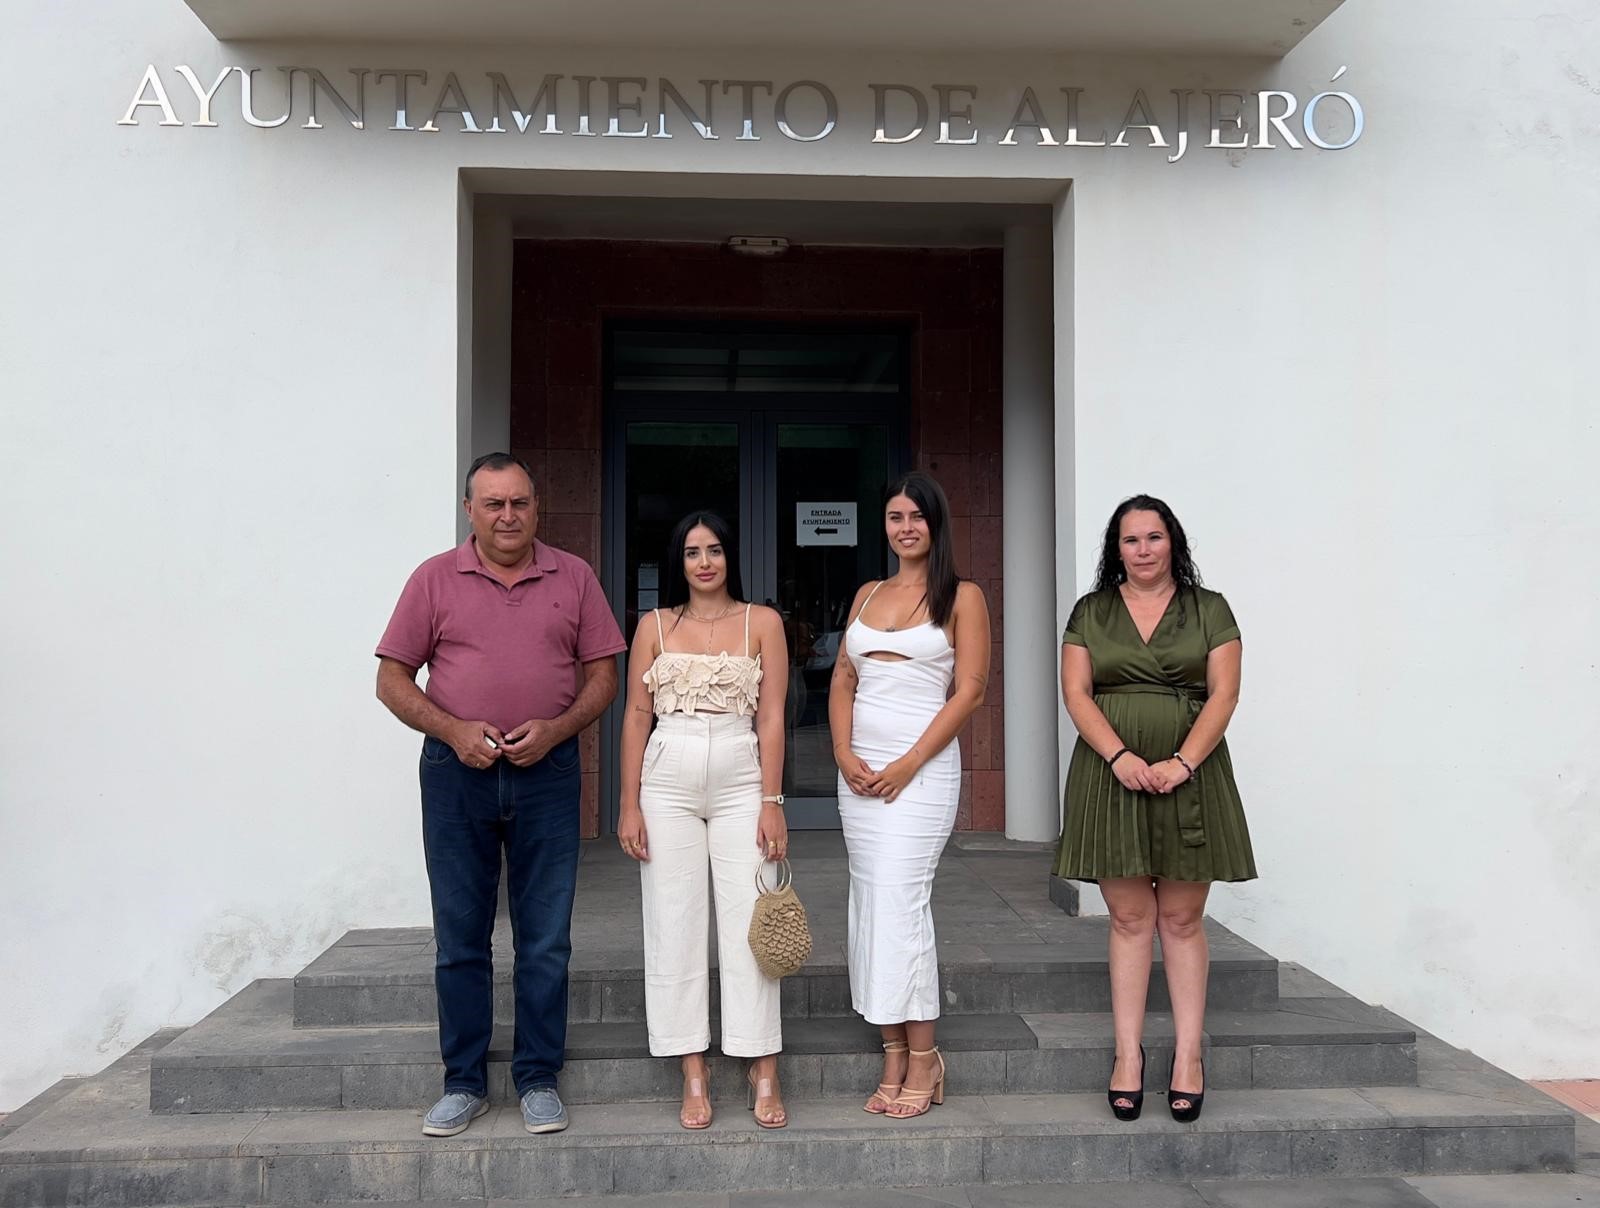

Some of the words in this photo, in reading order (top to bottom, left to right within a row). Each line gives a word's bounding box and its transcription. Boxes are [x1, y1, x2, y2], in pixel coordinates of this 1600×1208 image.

[117, 64, 837, 142] AYUNTAMIENTO
[869, 83, 978, 145] DE
[999, 66, 1364, 163] ALAJERÓ
[810, 509, 842, 517] ENTRADA
